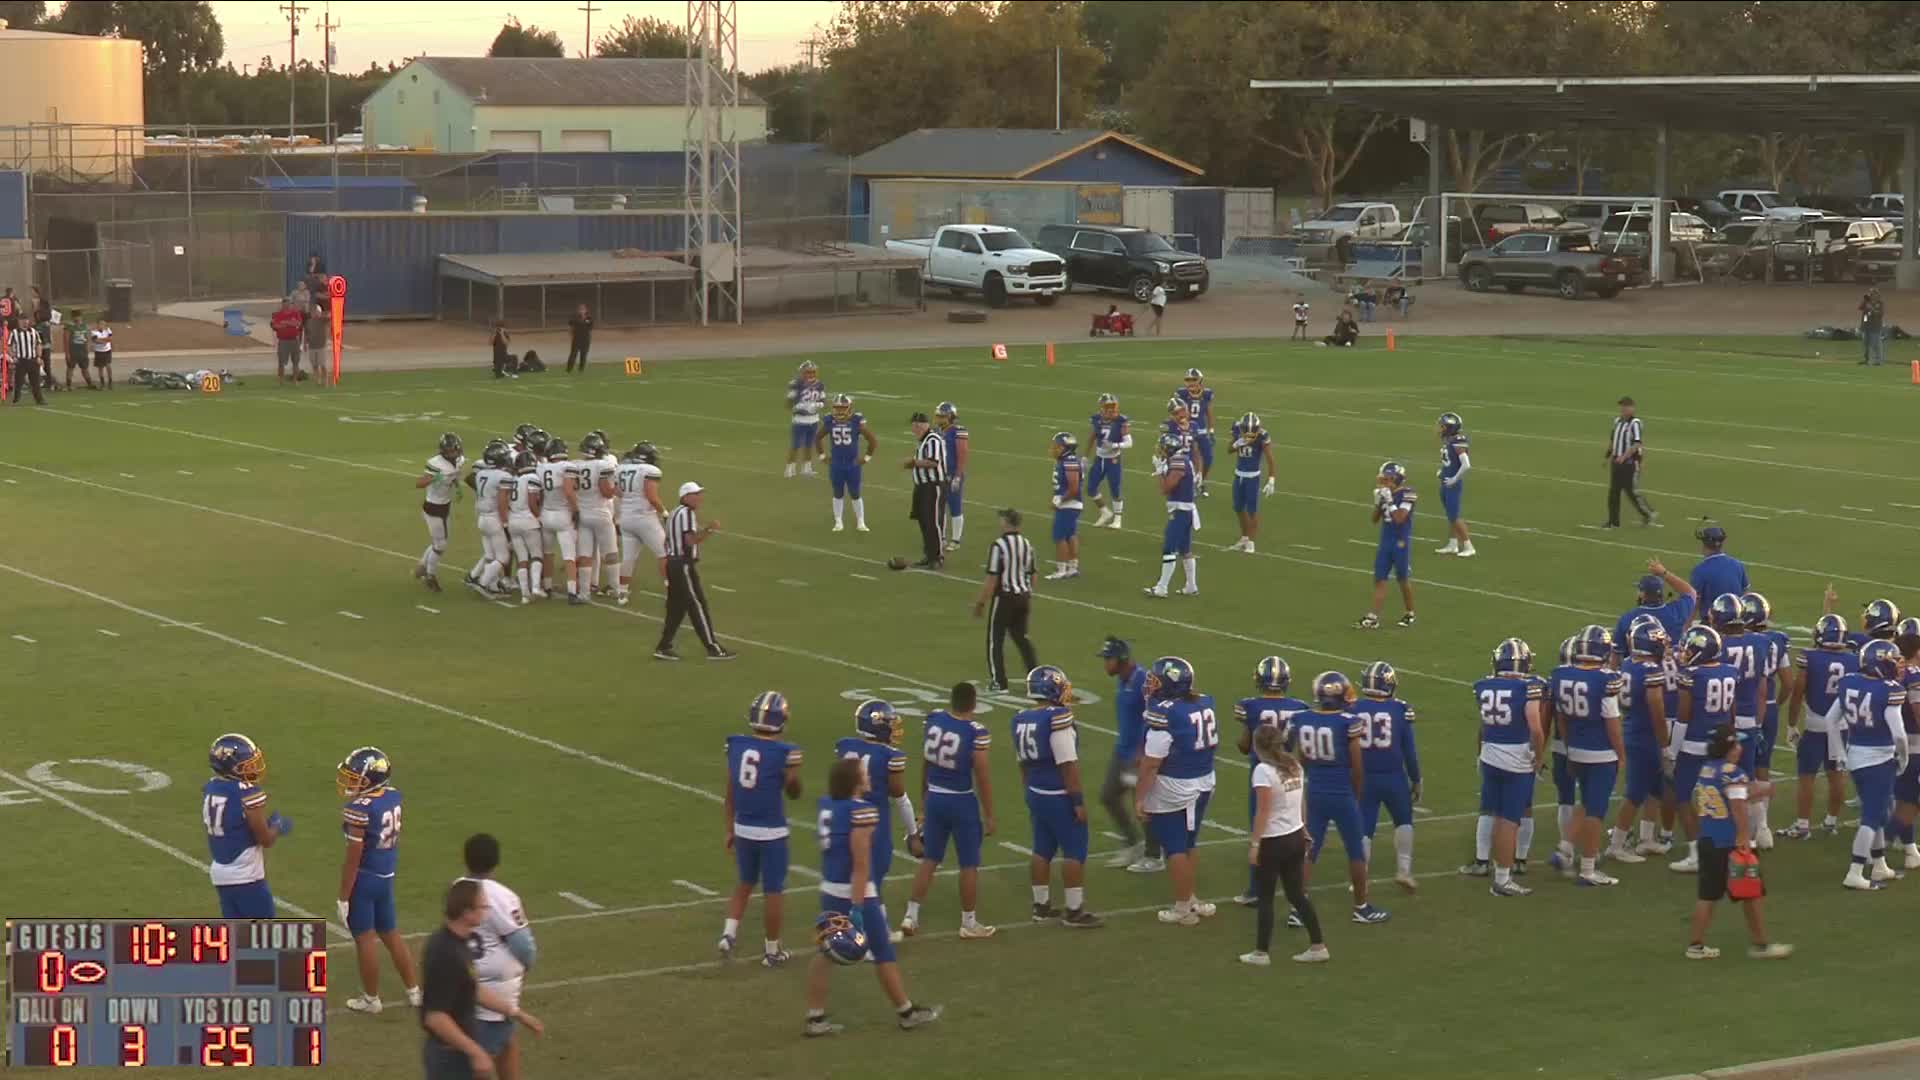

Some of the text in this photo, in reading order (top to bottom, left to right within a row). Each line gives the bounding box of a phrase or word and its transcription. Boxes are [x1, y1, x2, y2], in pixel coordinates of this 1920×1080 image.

[627, 359, 640, 373] 10
[995, 345, 1007, 358] G
[204, 376, 219, 390] 20
[832, 427, 852, 446] 55
[479, 476, 489, 498] 7
[543, 470, 554, 492] 6
[618, 470, 637, 493] 67
[1727, 646, 1756, 679] 71
[1480, 689, 1513, 726] 25
[1558, 679, 1590, 718] 56
[1704, 676, 1736, 713] 88
[1844, 688, 1875, 728] 54
[924, 725, 961, 769] 22
[1016, 723, 1039, 761] 75
[1188, 707, 1219, 751] 72
[1299, 725, 1336, 761] 80
[739, 748, 761, 789] 6
